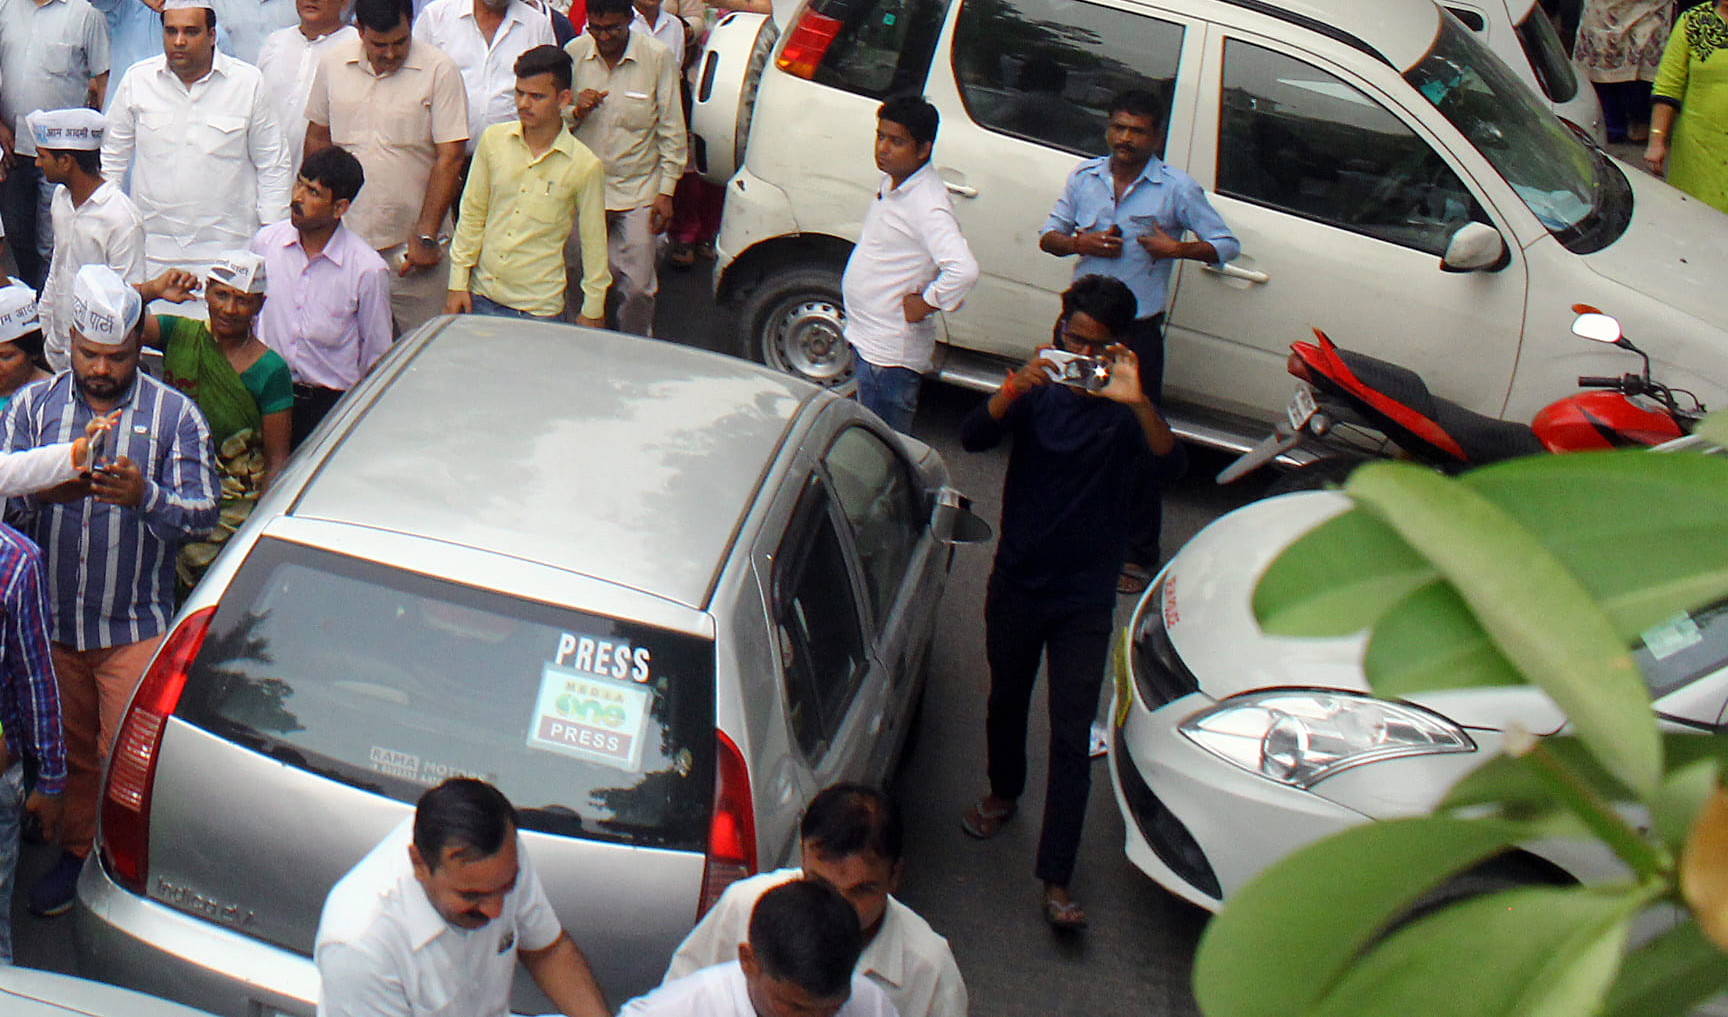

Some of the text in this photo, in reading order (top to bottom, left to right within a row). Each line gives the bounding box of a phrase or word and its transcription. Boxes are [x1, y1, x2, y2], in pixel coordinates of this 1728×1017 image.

[555, 632, 651, 683] PRESS
[565, 680, 625, 703] MEDIA
[551, 723, 619, 751] PRESS
[372, 747, 417, 769] RAMA
